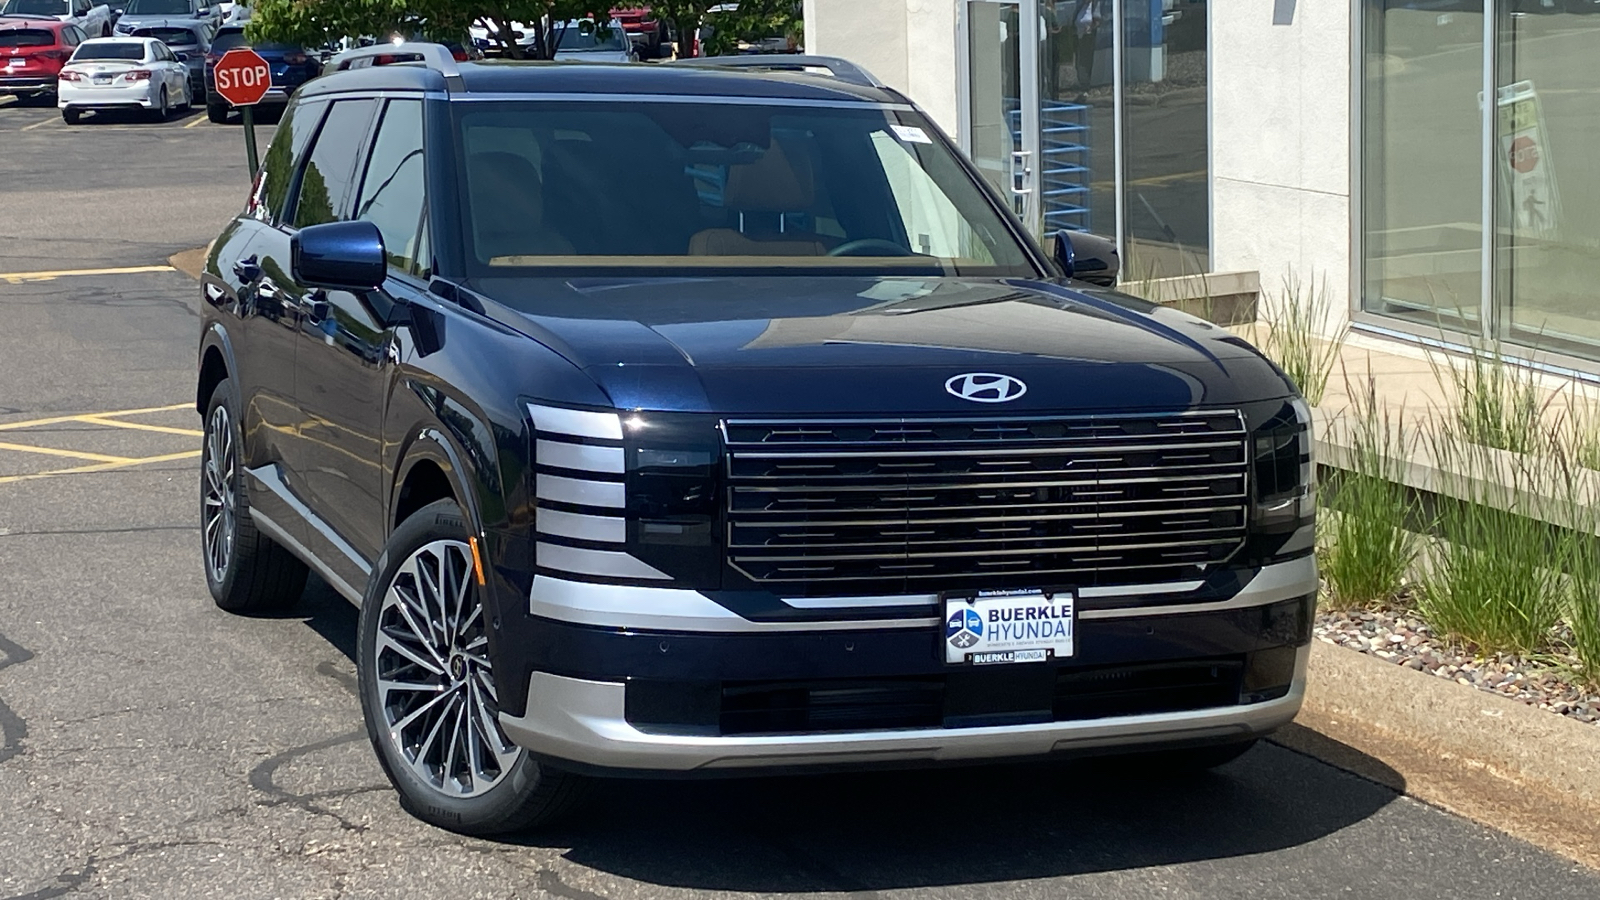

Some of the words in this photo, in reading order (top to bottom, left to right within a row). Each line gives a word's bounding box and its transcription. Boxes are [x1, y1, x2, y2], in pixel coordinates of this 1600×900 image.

[218, 65, 267, 89] STOP
[989, 605, 1071, 622] BUERKLE
[988, 619, 1071, 641] HYUNDAI
[974, 653, 1013, 663] BUERKLE
[1015, 651, 1045, 660] HYUNDAI
